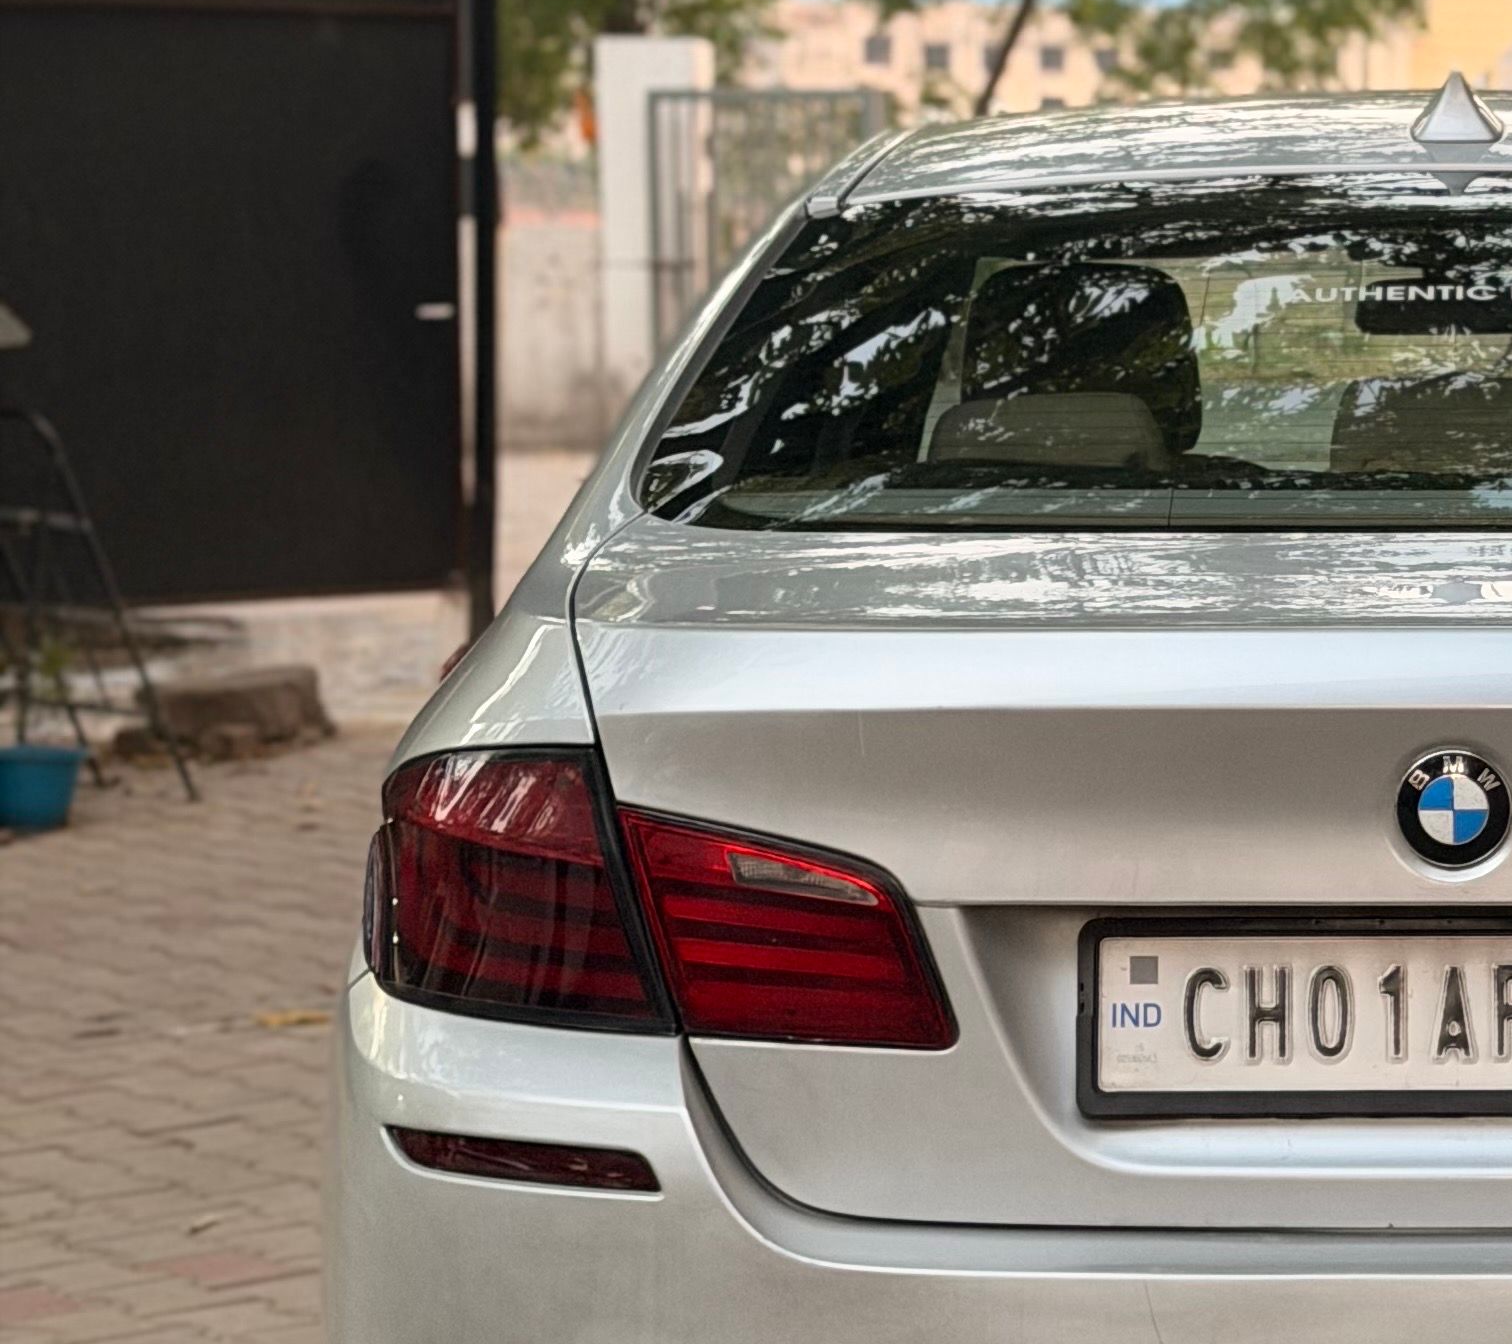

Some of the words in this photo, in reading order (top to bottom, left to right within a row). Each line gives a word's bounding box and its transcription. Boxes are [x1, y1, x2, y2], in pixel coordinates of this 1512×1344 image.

[1291, 285, 1498, 302] AUTHENTIC
[1408, 755, 1500, 792] BMW
[1111, 1002, 1162, 1028] IND
